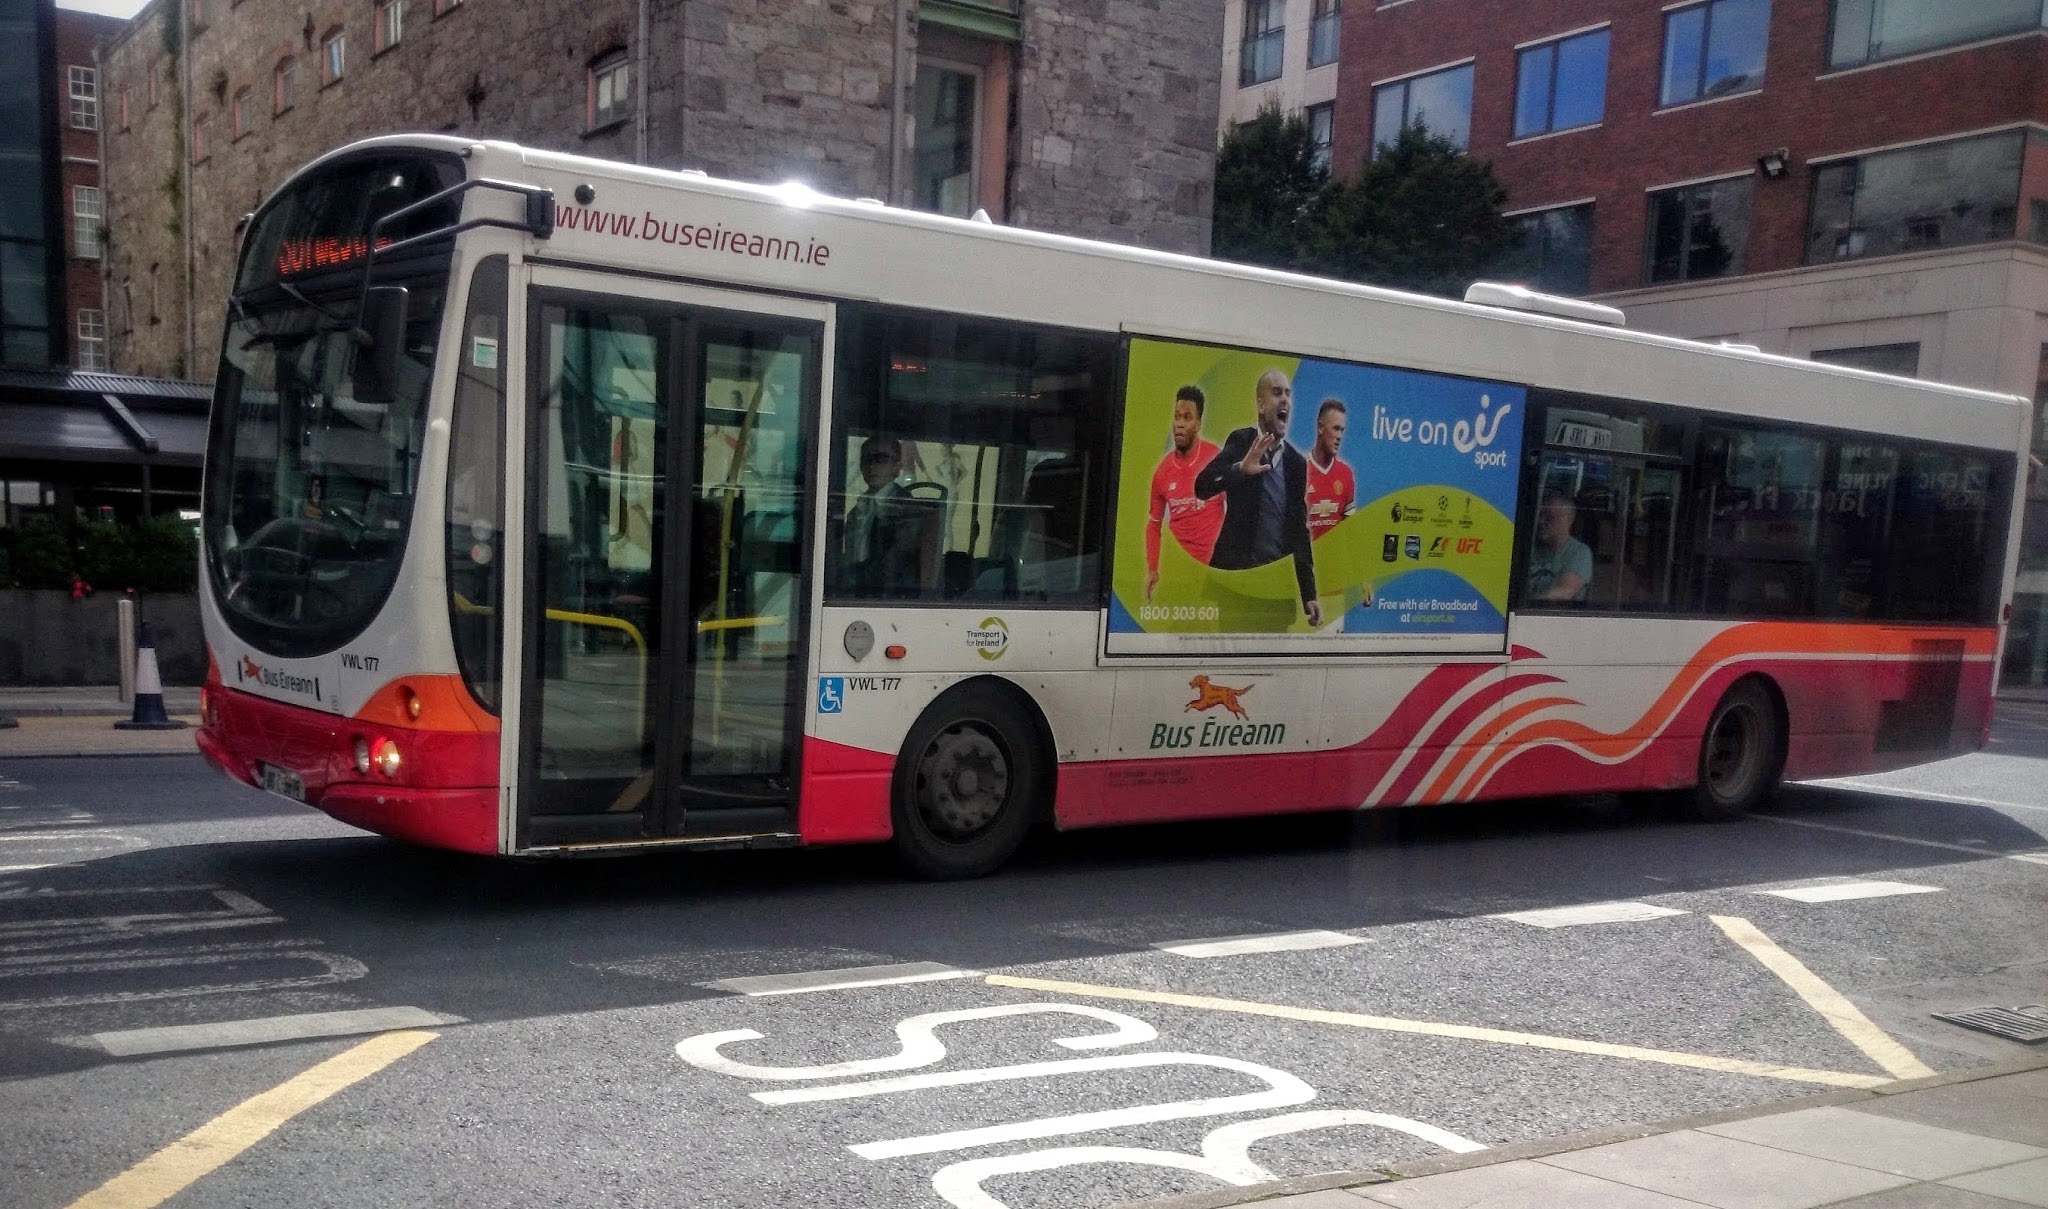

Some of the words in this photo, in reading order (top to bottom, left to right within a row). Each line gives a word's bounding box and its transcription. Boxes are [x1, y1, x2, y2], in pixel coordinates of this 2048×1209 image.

[555, 204, 831, 267] www.buseireann.ie
[1372, 404, 1413, 443] live
[1418, 420, 1448, 446] on
[1452, 394, 1512, 454] eir
[1474, 450, 1507, 469] sport
[1456, 537, 1484, 554] UFC
[1378, 598, 1398, 610] Free
[1399, 598, 1417, 611] with
[1418, 599, 1430, 611] eir
[1431, 599, 1478, 611] Broadband
[1139, 606, 1170, 621] 1800
[1172, 606, 1196, 621] 303
[1199, 606, 1220, 621] 601
[1400, 612, 1411, 623] at
[966, 630, 1000, 639] Transport
[975, 639, 1000, 647] Ireland
[341, 653, 363, 669] VWL
[364, 656, 380, 671] 177
[263, 667, 279, 687] Bus
[849, 677, 878, 691] VWL
[881, 677, 902, 691] 177
[1149, 722, 1196, 750] Bus
[1199, 716, 1286, 748] Éireann
